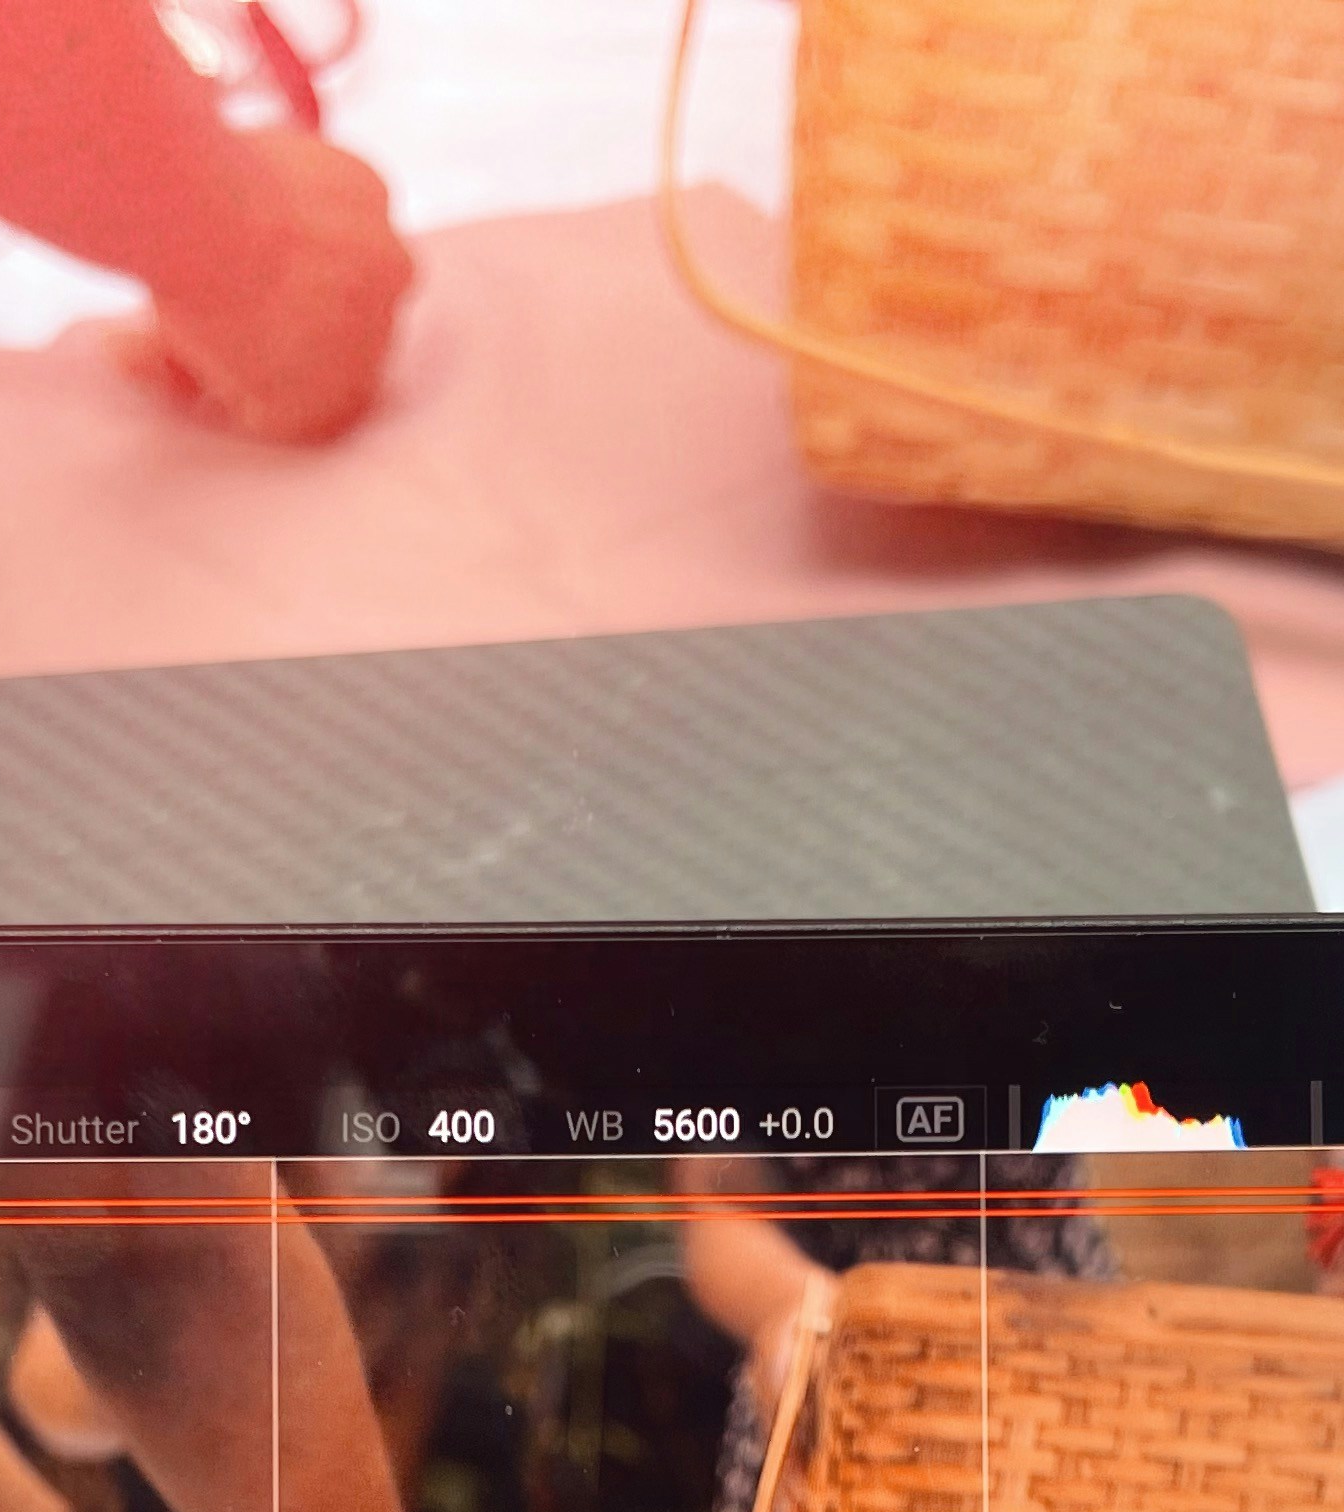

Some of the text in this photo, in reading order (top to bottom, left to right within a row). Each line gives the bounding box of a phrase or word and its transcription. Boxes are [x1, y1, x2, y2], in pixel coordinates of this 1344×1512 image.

[10, 1110, 252, 1147] Shutter 180°
[341, 1110, 496, 1144] ISO 400
[566, 1107, 835, 1143] WB 5600 +0.0
[907, 1105, 953, 1135] AF
